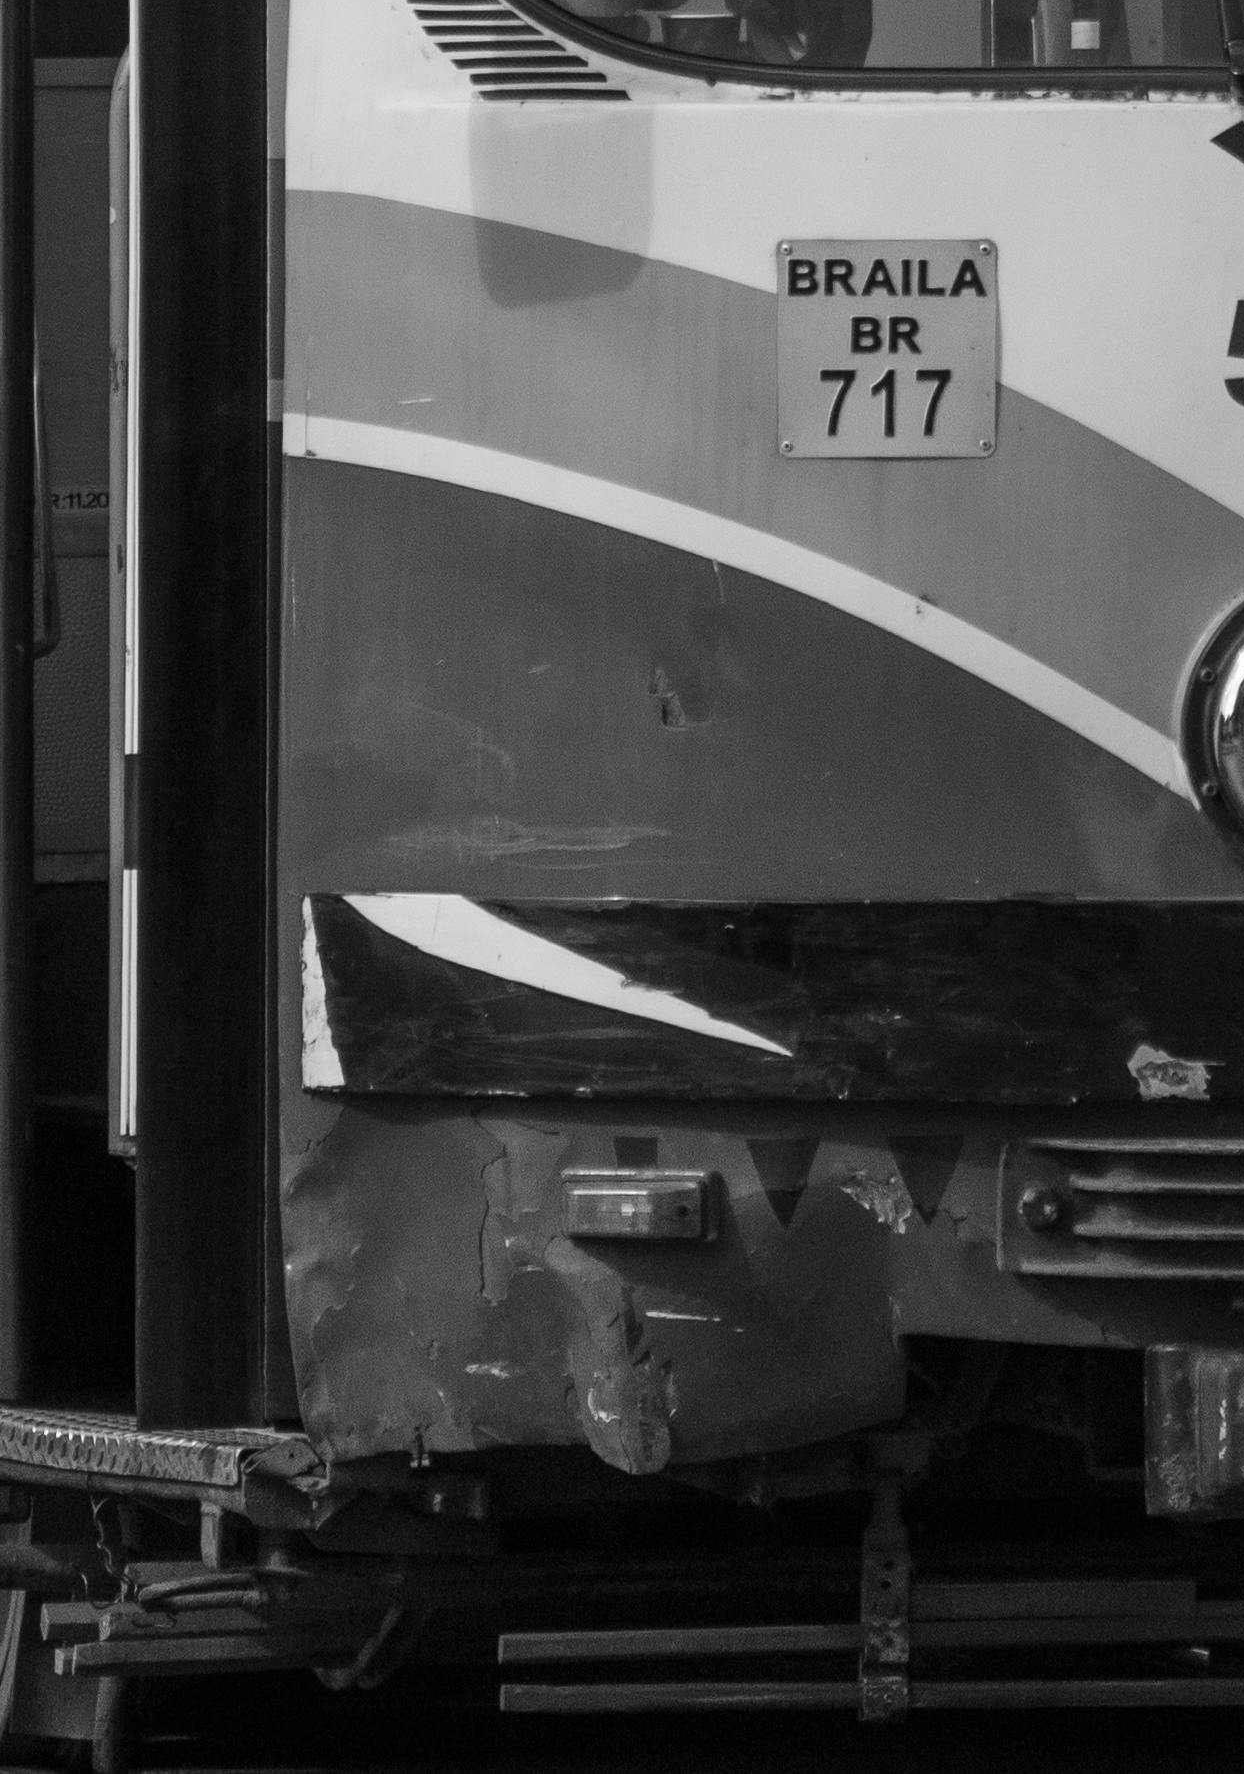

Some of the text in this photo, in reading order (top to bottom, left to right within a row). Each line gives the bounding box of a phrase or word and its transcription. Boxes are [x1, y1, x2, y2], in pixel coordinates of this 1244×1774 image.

[787, 258, 988, 298] BRAILA
[850, 315, 922, 355] BR
[819, 369, 952, 439] 717
